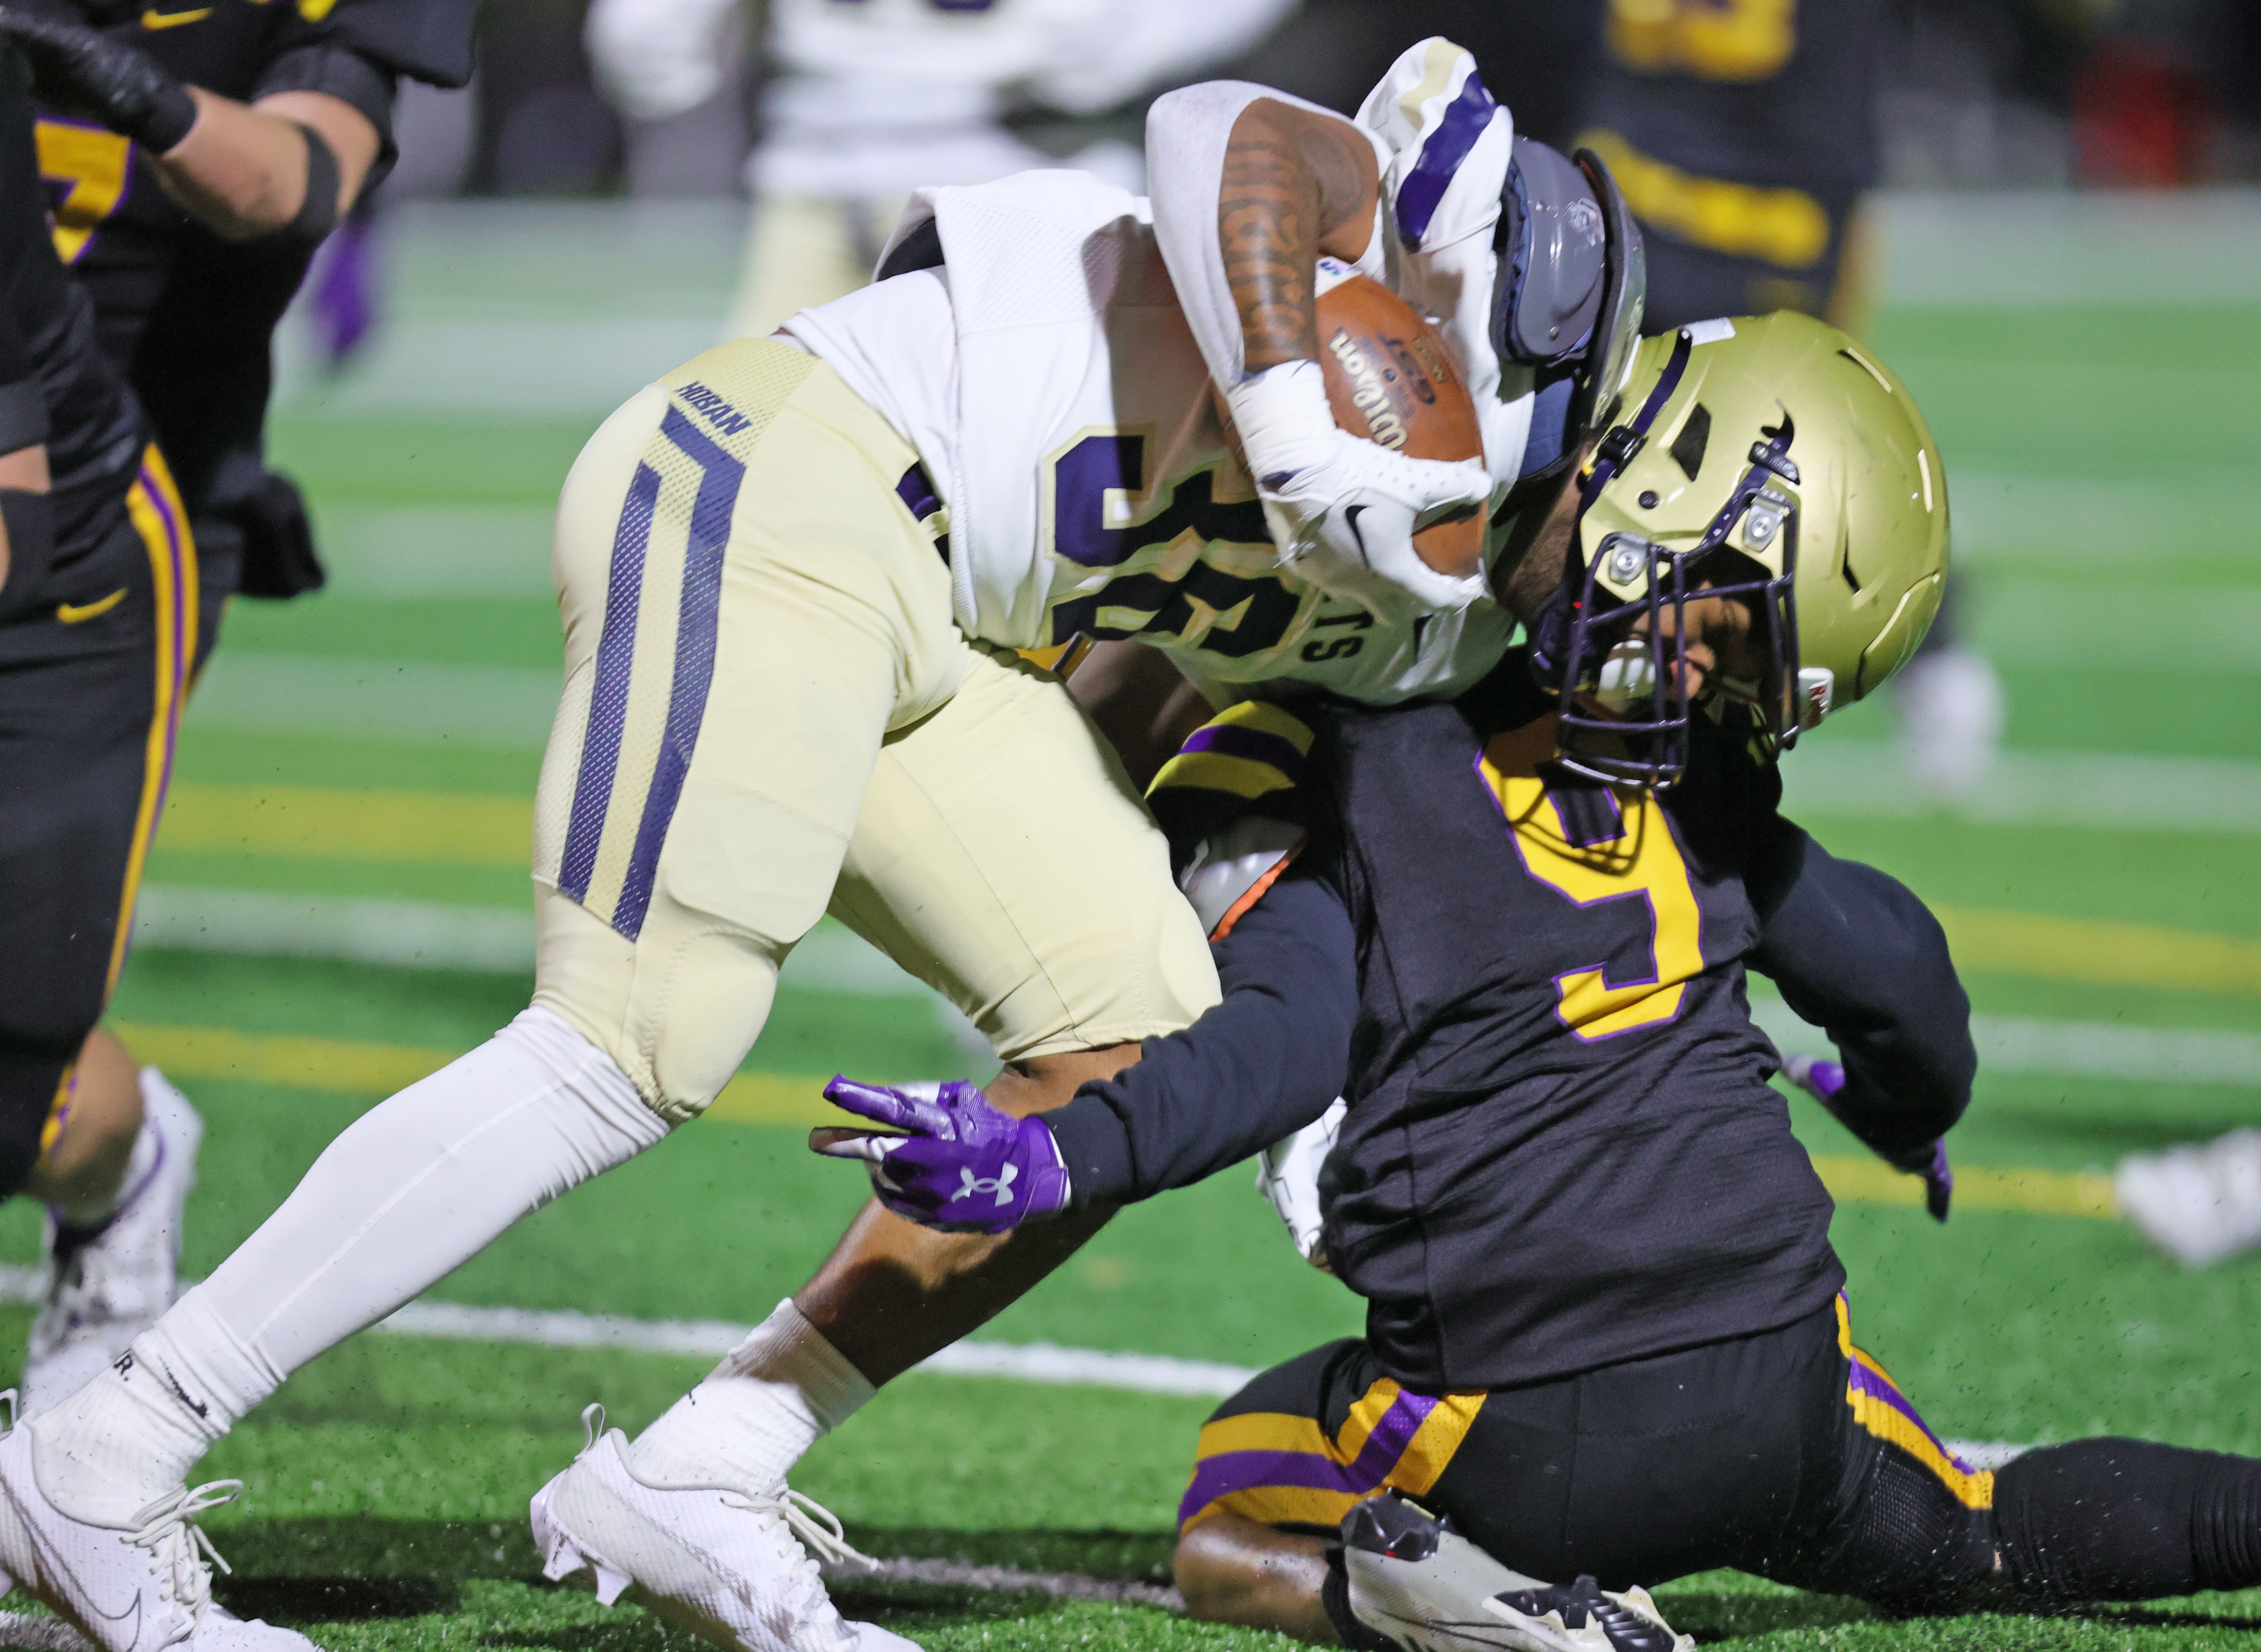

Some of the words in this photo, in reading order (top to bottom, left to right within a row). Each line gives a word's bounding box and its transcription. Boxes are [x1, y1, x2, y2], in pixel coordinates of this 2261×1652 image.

[674, 379, 752, 436] HOBAN
[1328, 326, 1408, 451] Wilson
[1472, 718, 1705, 1044] 9
